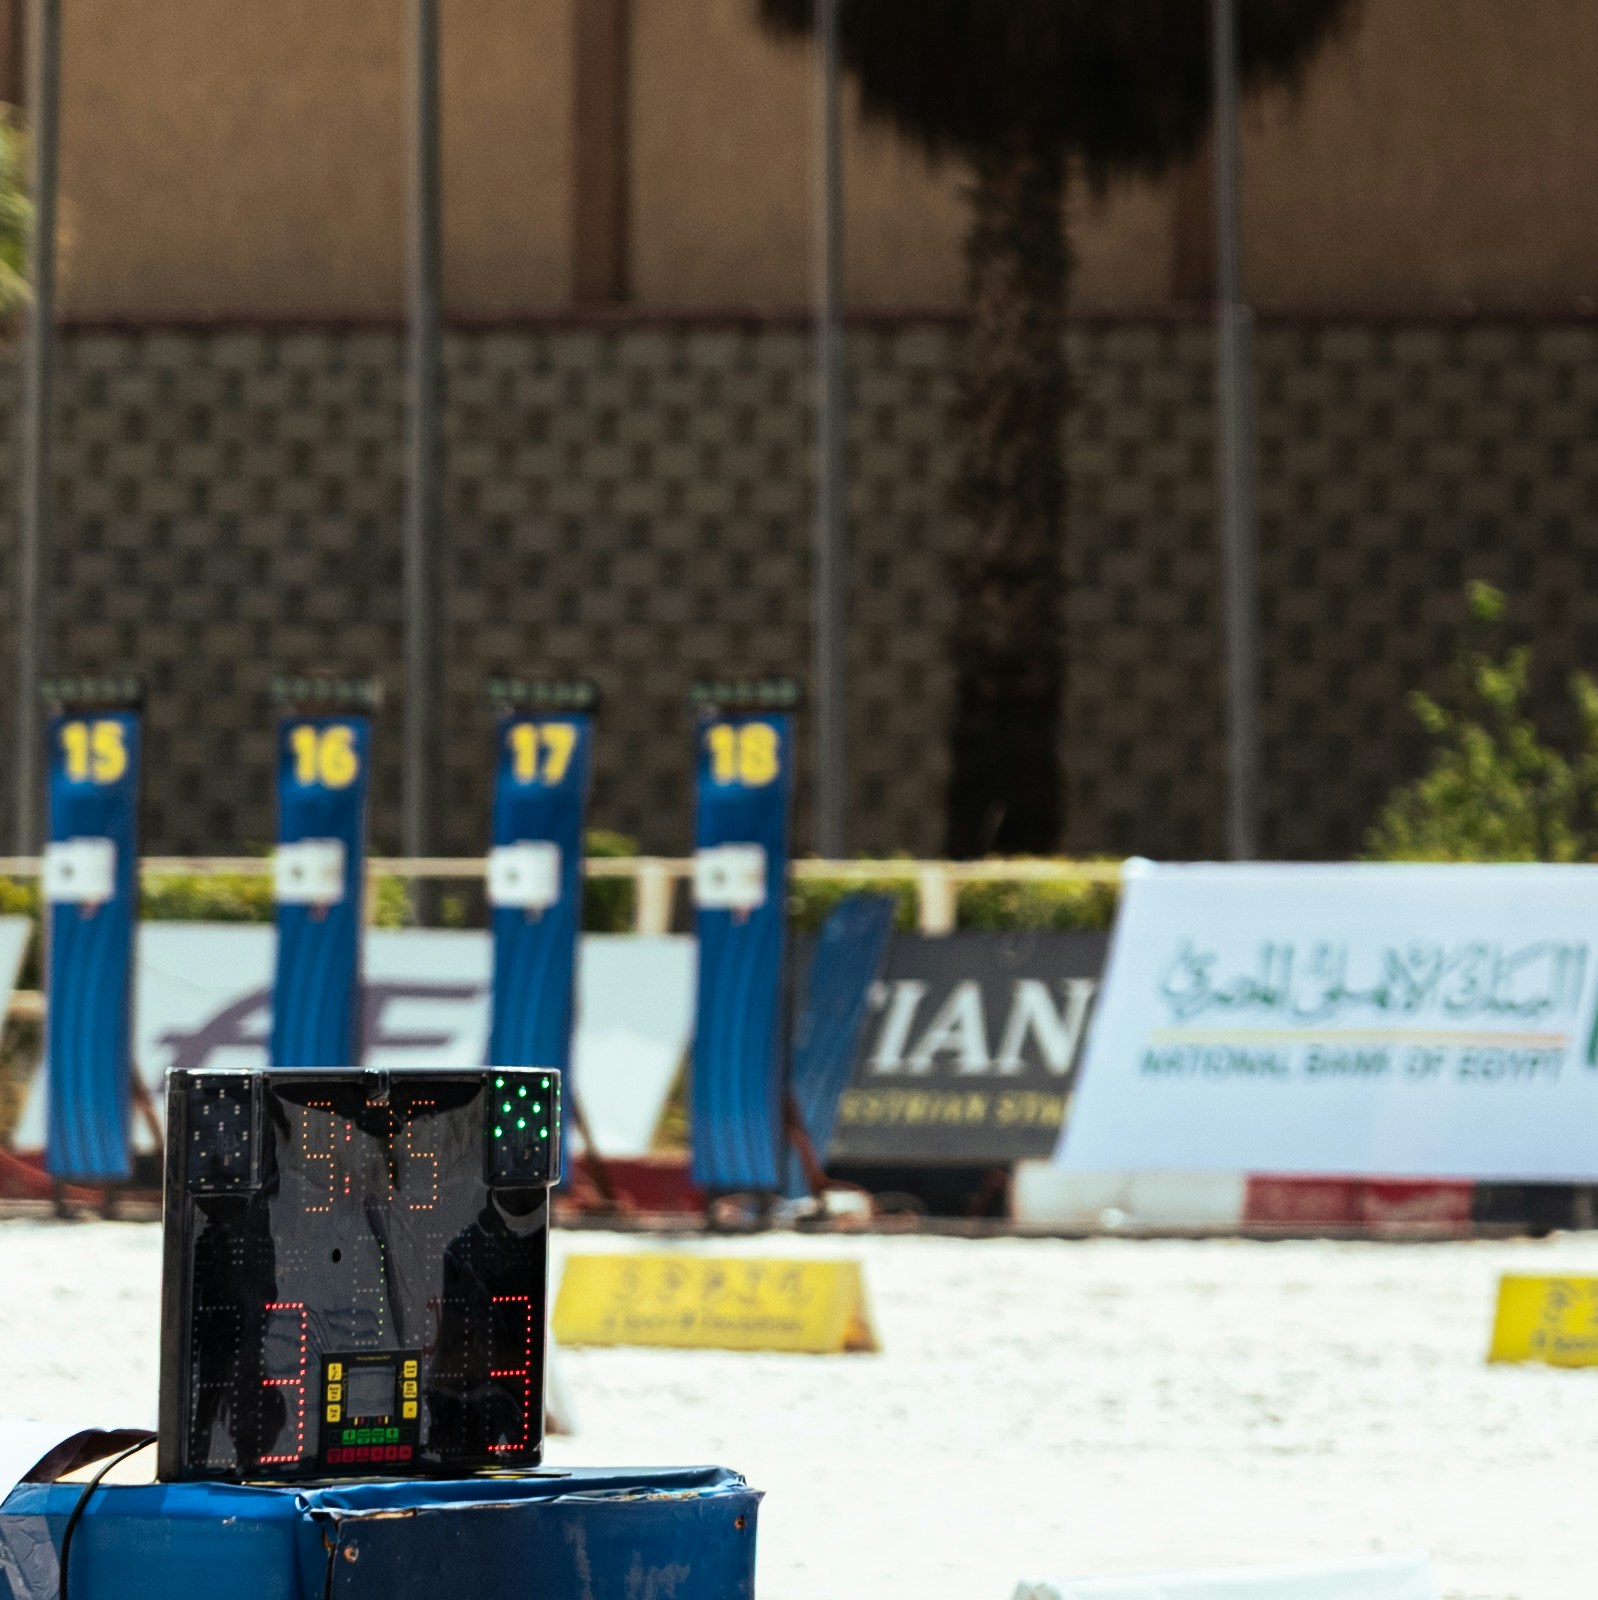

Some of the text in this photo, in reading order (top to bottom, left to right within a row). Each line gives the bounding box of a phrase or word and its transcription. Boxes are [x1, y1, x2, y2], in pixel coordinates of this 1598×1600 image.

[61, 719, 129, 785] 15
[288, 724, 359, 789] 16
[511, 721, 578, 787] 17
[707, 721, 780, 787] 18
[868, 979, 1094, 1077] IAN
[1304, 1045, 1391, 1079] BANK
[258, 1299, 308, 1464] 3
[488, 1294, 532, 1452] 3
